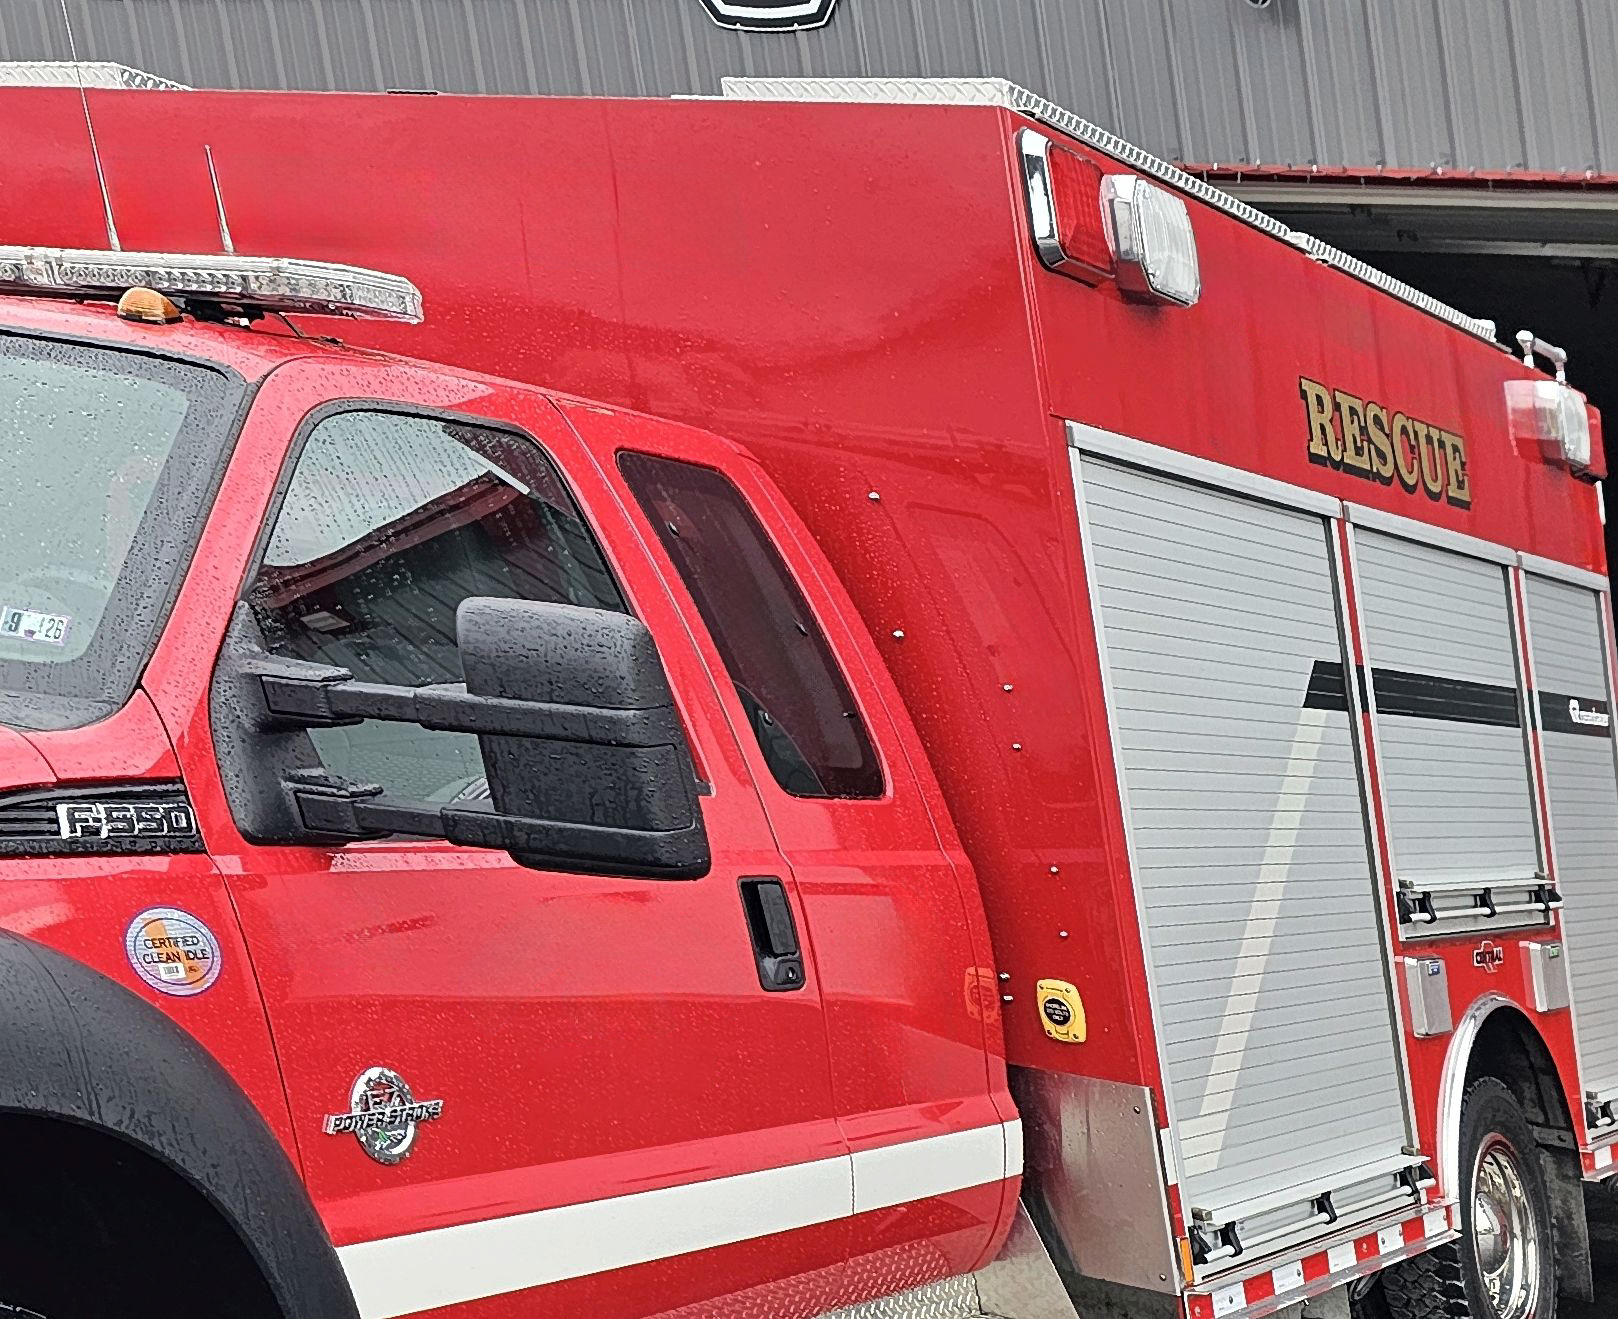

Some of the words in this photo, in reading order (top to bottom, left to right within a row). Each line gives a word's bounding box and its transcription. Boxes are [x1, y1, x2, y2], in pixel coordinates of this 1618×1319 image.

[1299, 375, 1472, 510] RESCUE
[143, 936, 200, 949] CERTIFIED
[143, 951, 182, 964] CLEAN
[184, 949, 210, 961] IDLE
